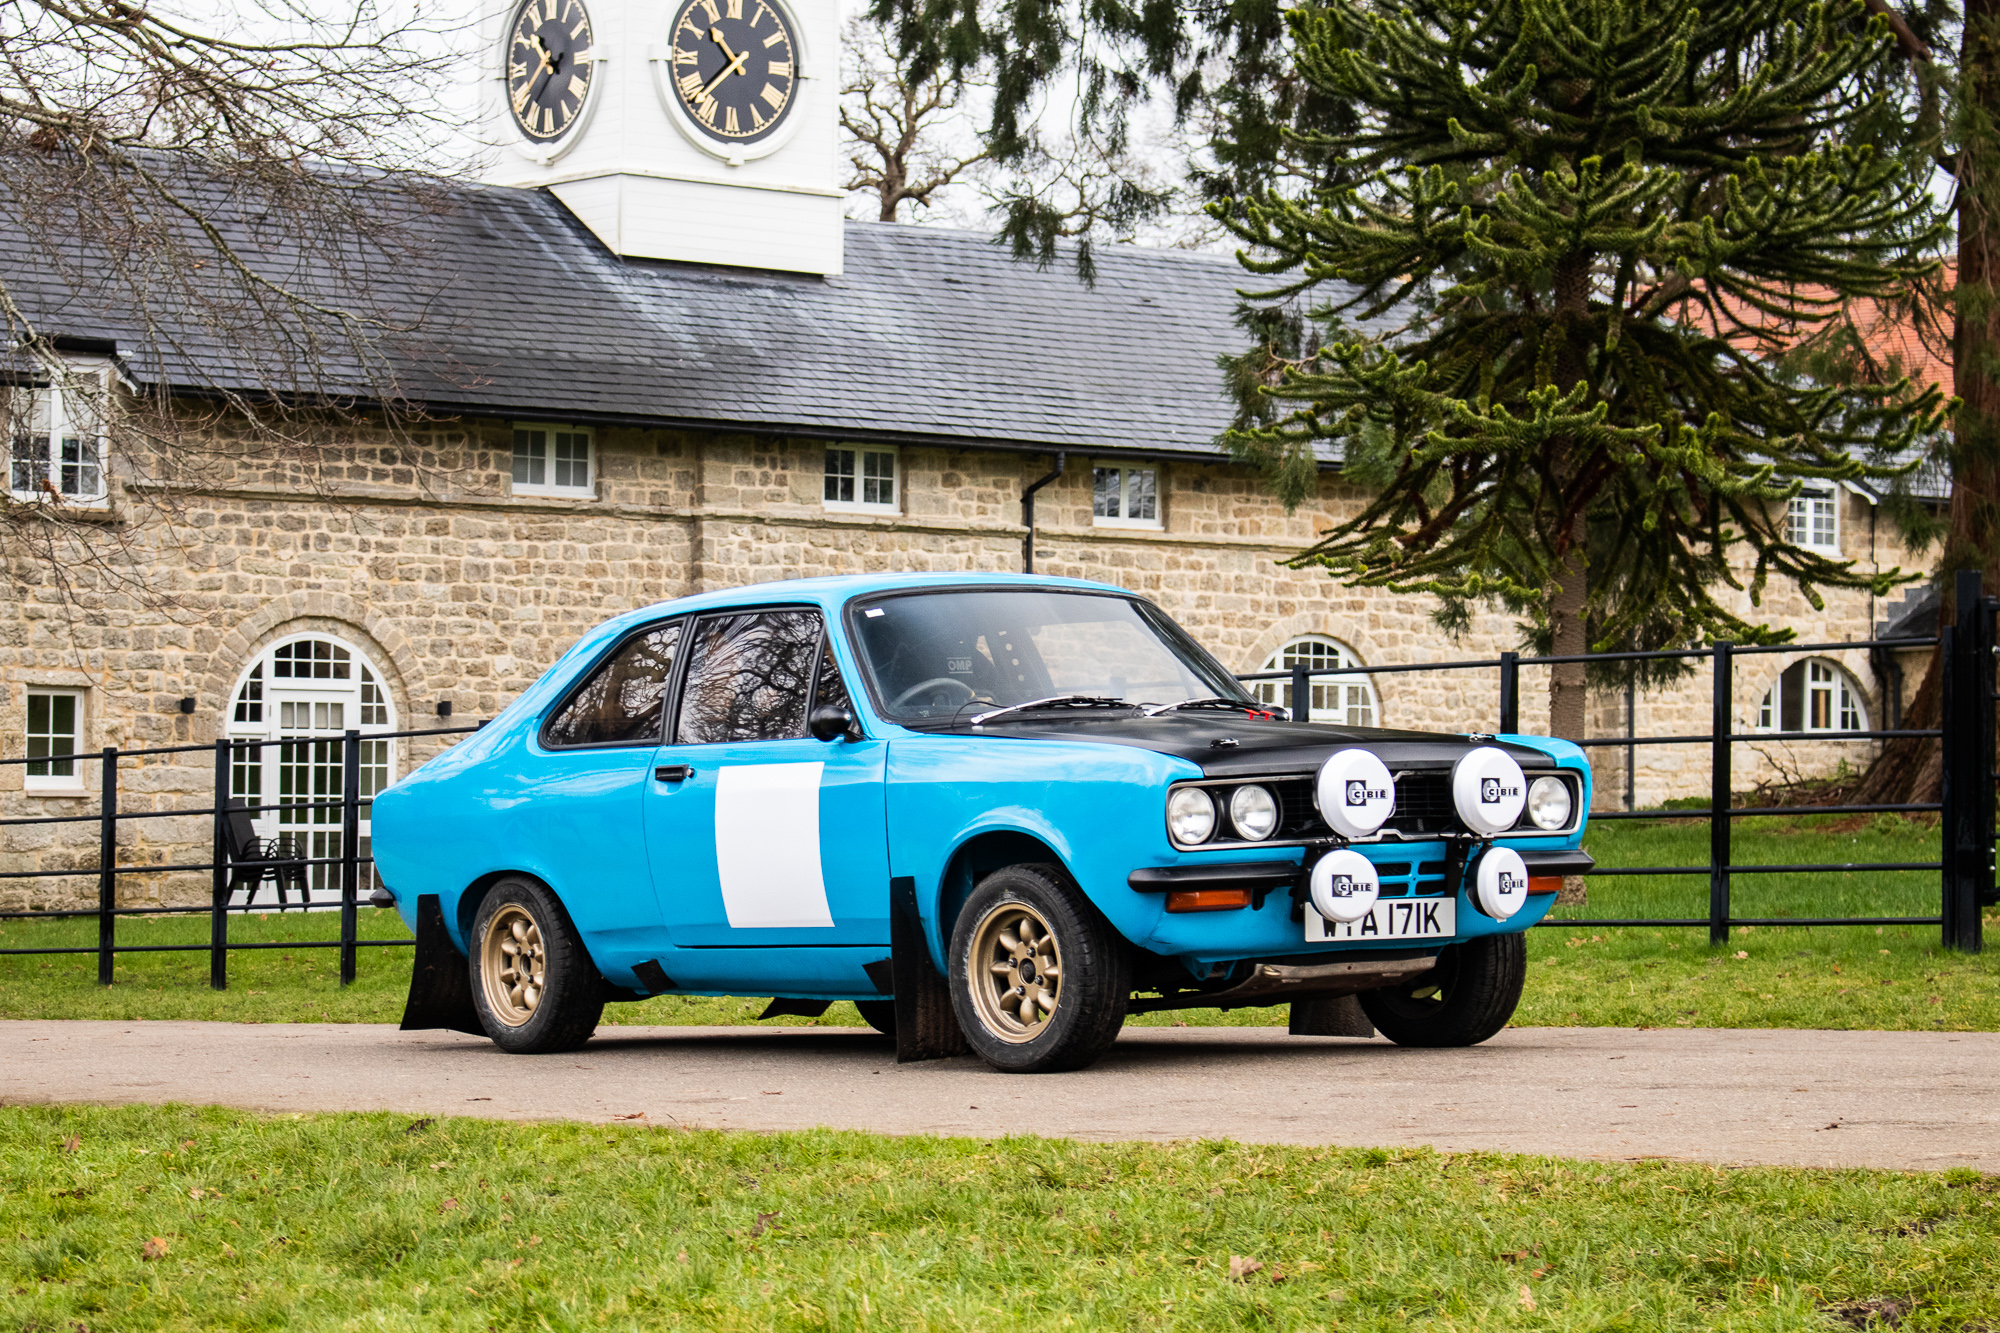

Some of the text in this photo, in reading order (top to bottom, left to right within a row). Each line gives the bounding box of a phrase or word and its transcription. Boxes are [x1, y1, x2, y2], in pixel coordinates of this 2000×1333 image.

[749, 5, 765, 28] I
[680, 17, 705, 40] X
[762, 30, 784, 49] II
[768, 60, 790, 77] III
[947, 660, 972, 671] OMP
[1388, 902, 1441, 935] 171K
